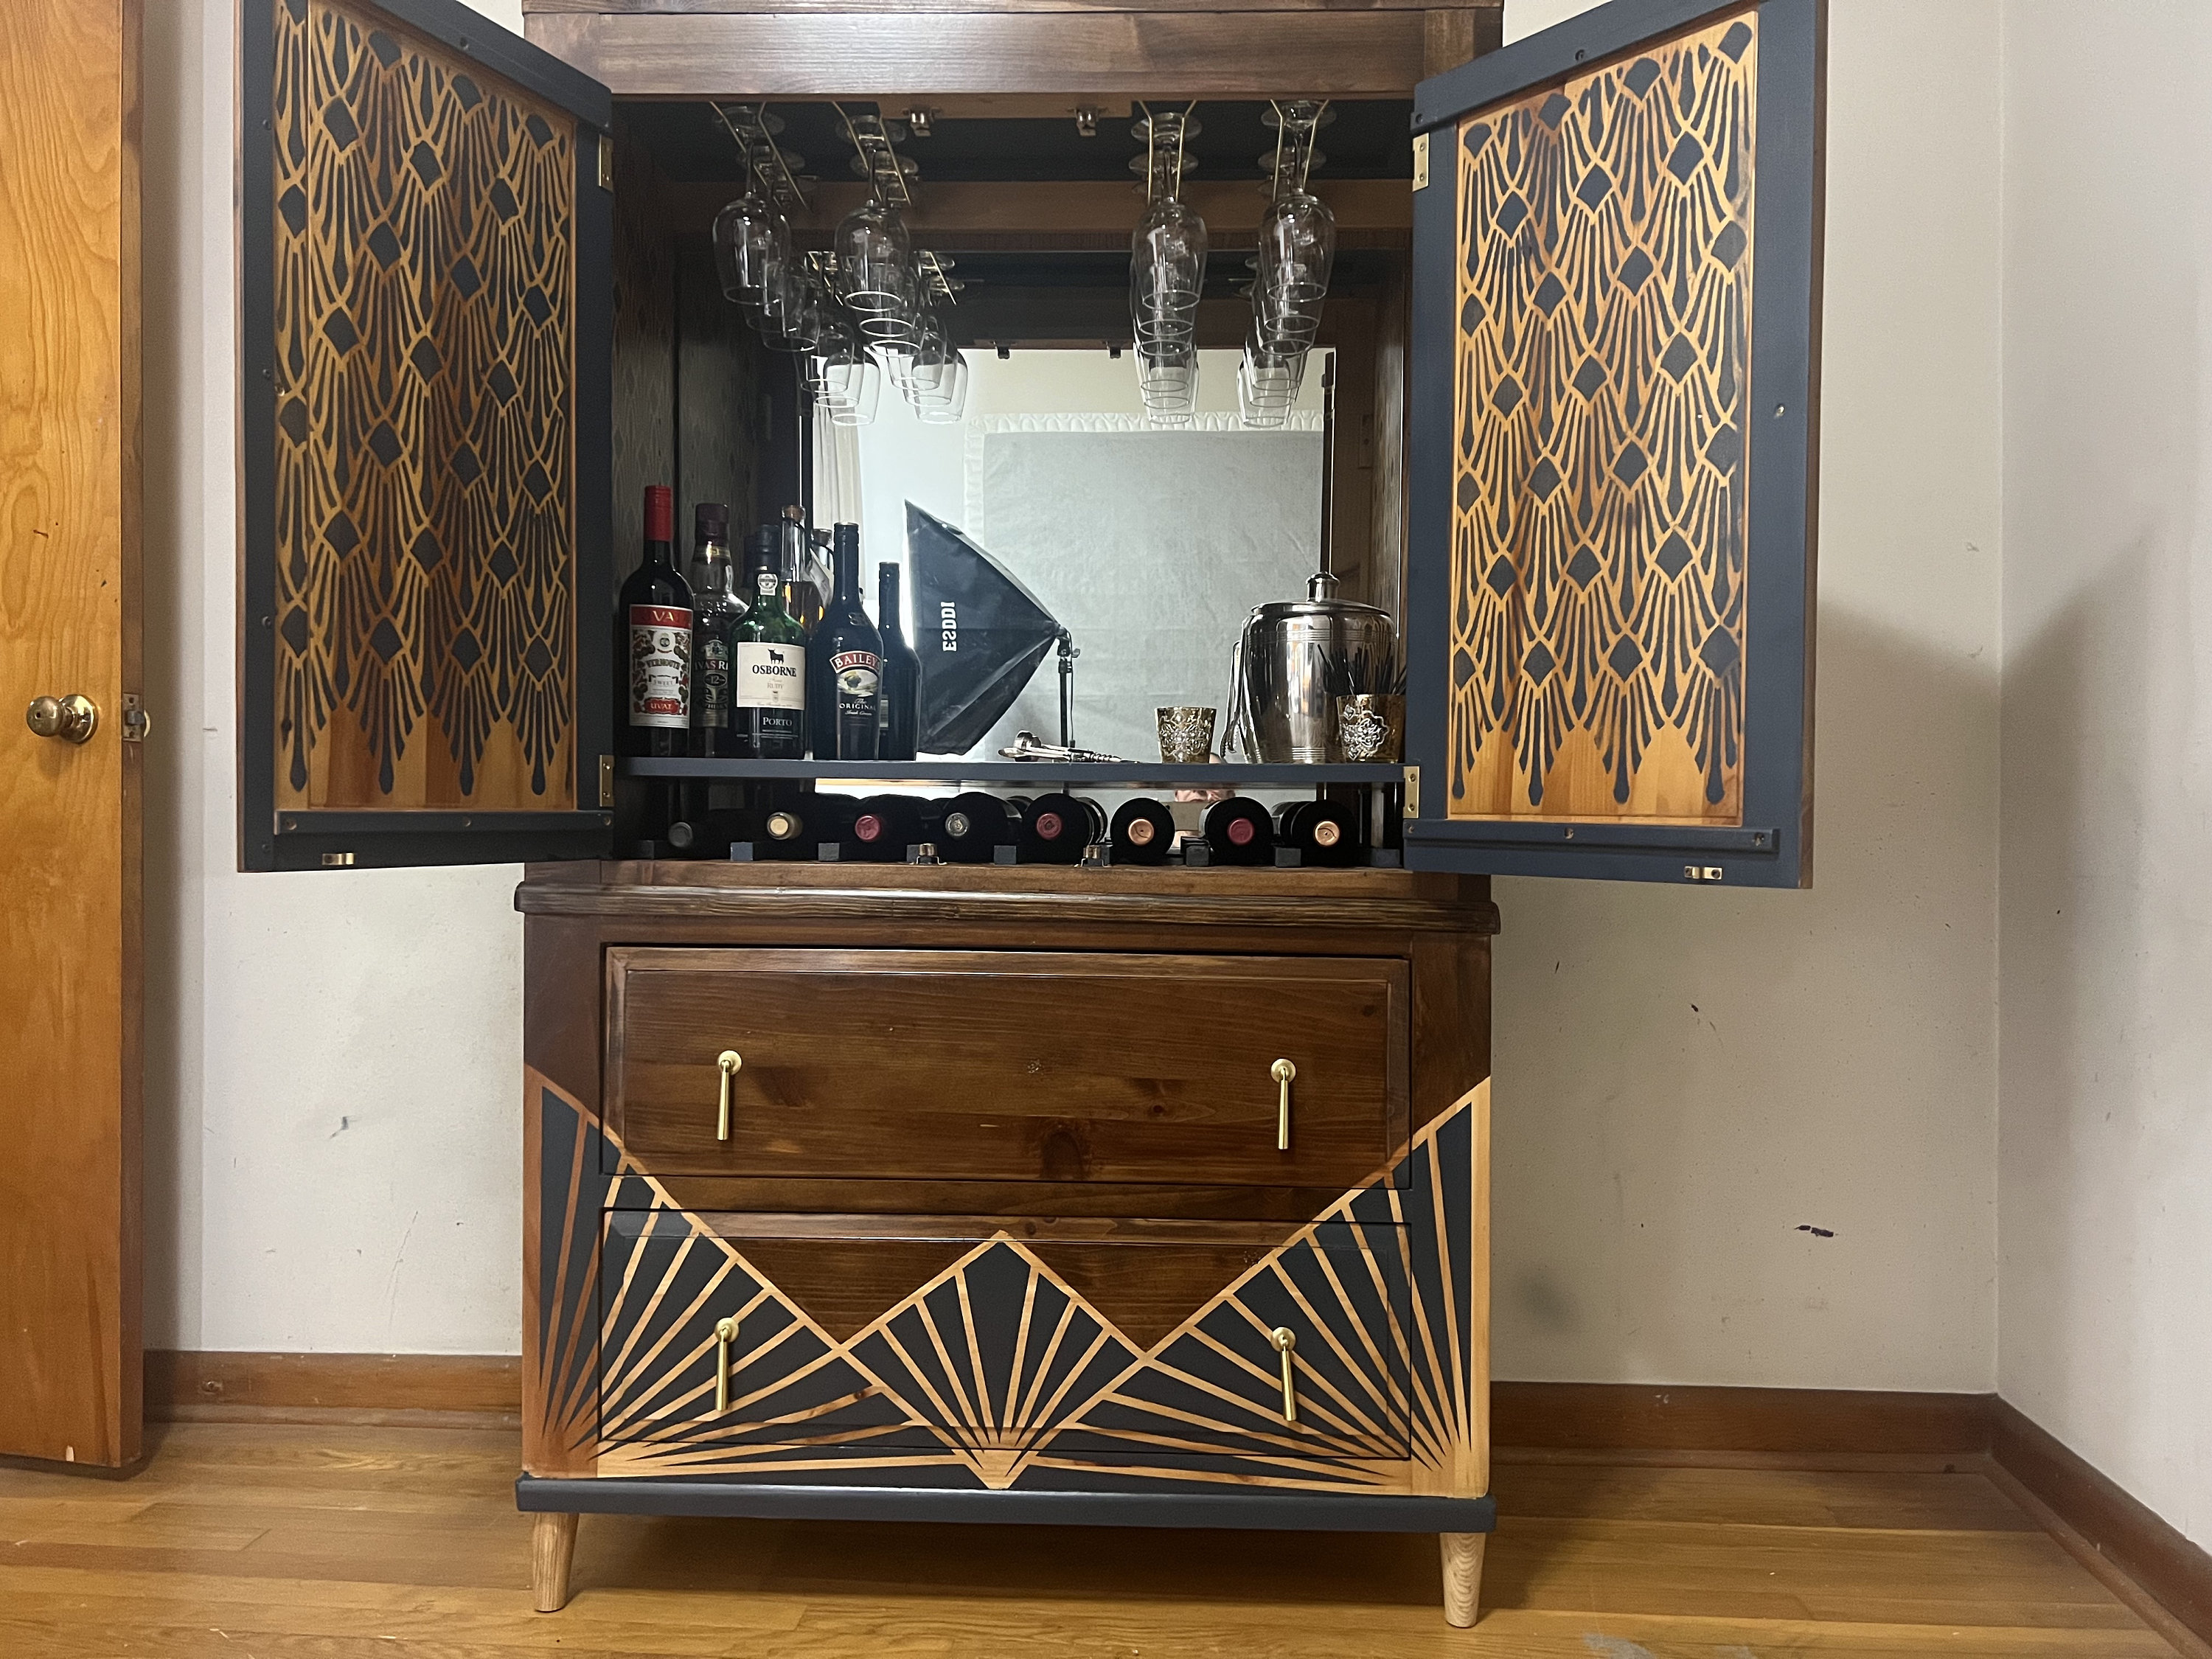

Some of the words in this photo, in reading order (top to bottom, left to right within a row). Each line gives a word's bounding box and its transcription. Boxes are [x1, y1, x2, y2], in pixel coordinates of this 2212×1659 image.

[835, 654, 880, 669] BAILEYS
[752, 664, 797, 677] OSBORNE
[839, 703, 876, 711] ORIGINAL
